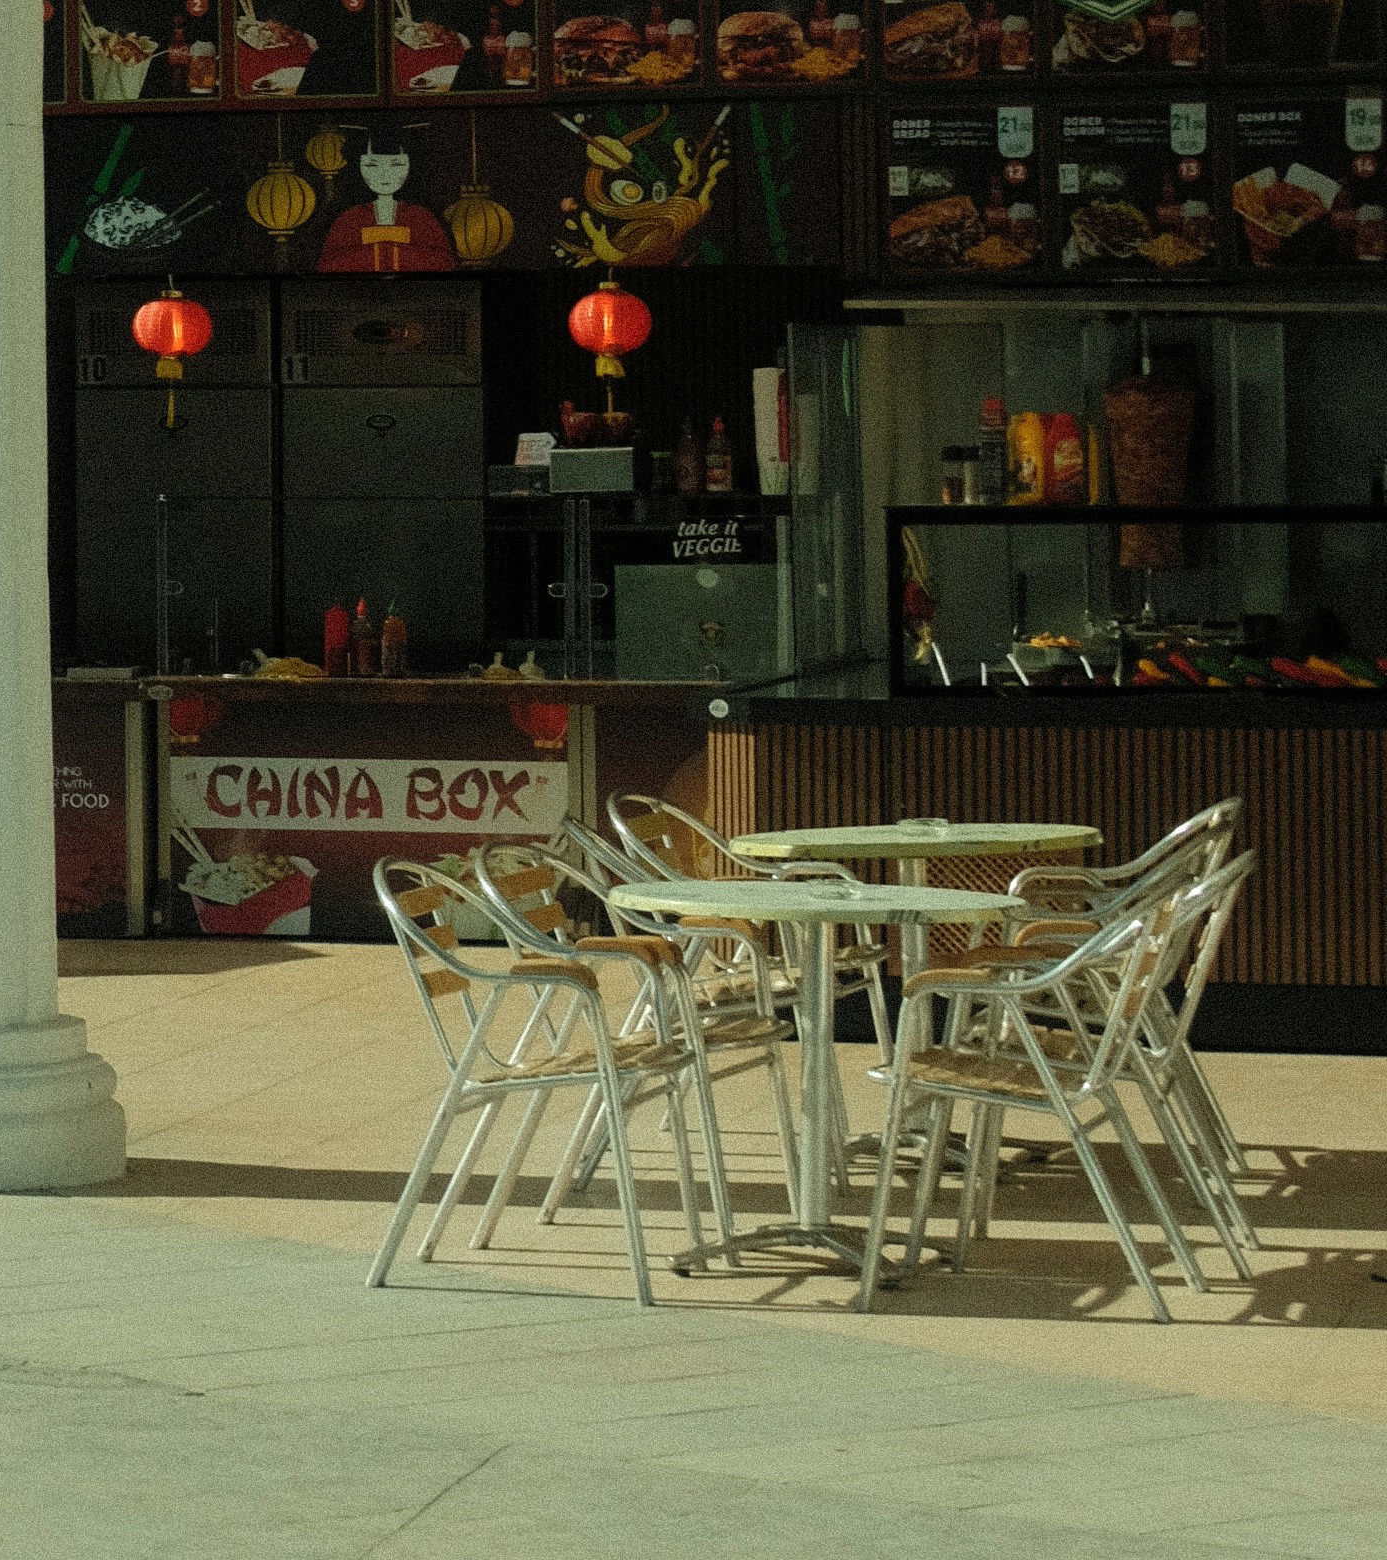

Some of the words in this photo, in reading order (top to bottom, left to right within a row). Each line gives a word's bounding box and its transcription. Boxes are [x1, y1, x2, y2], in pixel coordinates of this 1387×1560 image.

[192, 0, 202, 12] 2
[677, 518, 719, 538] take
[723, 520, 740, 536] it
[672, 537, 743, 560] VEGGIE
[62, 778, 94, 790] WITH
[203, 763, 383, 820] CHINA
[405, 766, 531, 823] BOX
[61, 792, 111, 810] FOOD
